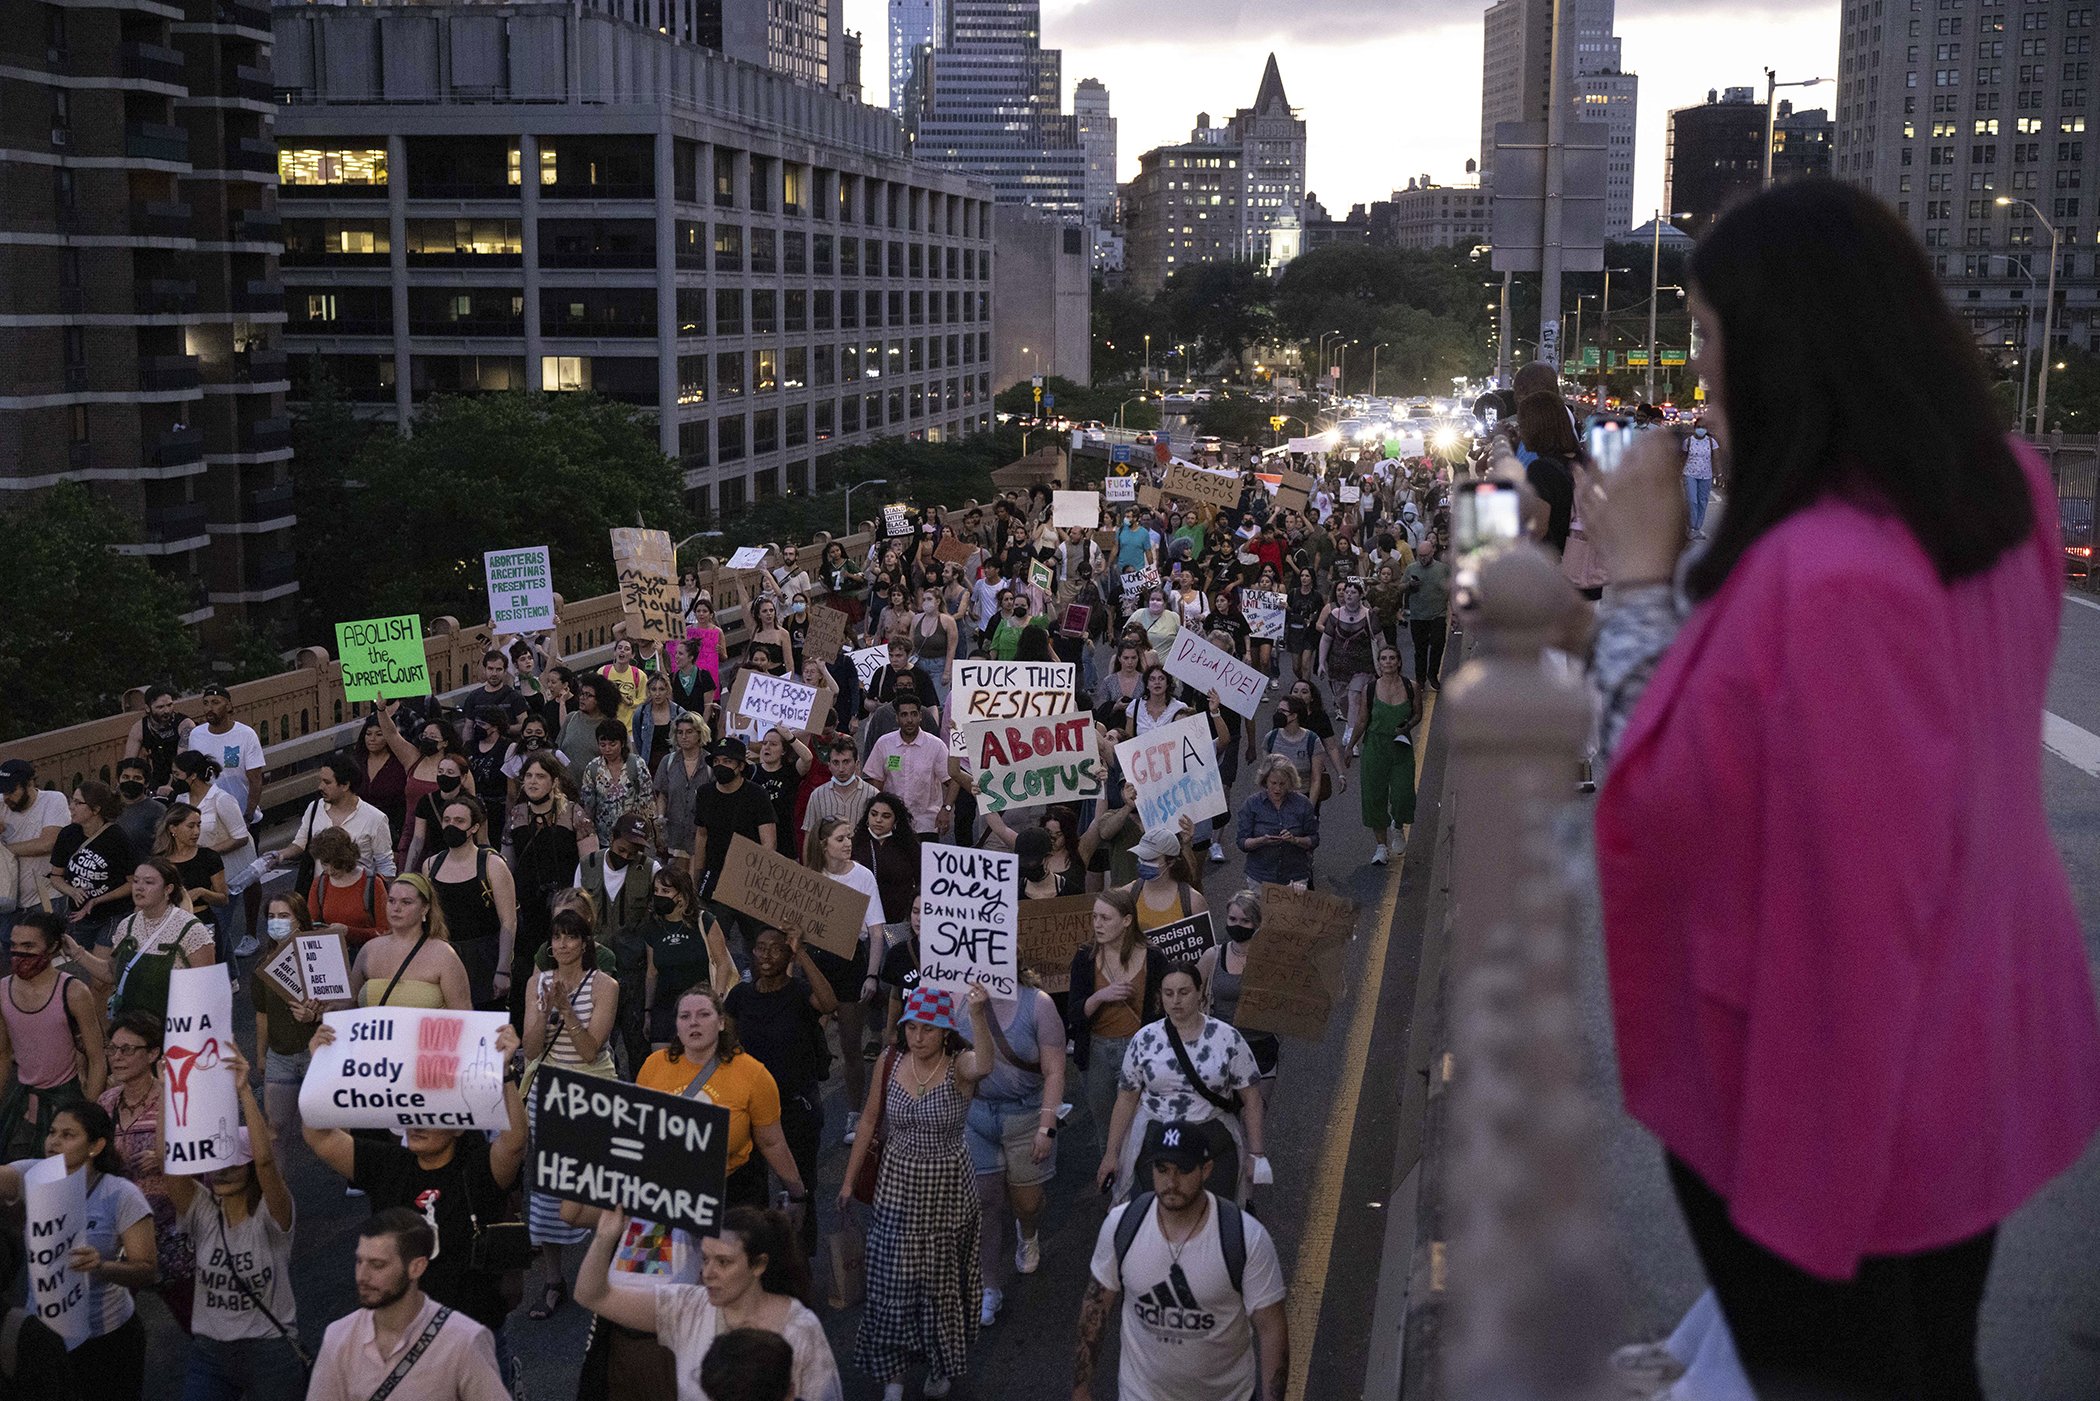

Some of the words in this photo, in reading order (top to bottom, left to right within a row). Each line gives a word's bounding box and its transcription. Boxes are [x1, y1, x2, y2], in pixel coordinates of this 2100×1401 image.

[1107, 479, 1132, 488] FUCK
[1173, 466, 1208, 482] FUCK
[1212, 473, 1234, 489] YOU
[884, 506, 905, 514] STAND
[492, 578, 546, 593] PRESENTES
[511, 595, 528, 607] EN
[495, 606, 549, 622] RESISTENCIA
[343, 618, 414, 648] ABOLISH
[367, 647, 389, 664] the
[961, 665, 1018, 688] FUCK
[1025, 666, 1073, 689] THIS!
[751, 676, 781, 697] MY
[781, 683, 815, 706] BODY
[745, 696, 771, 713] MY
[771, 703, 810, 721] CHOICE
[980, 717, 1091, 770] ABORT
[1131, 740, 1176, 785] GET
[1183, 735, 1205, 773] A
[978, 758, 1102, 812] SCOTUS
[78, 856, 97, 870] OUR
[768, 859, 795, 883] YOU
[932, 850, 1012, 883] YOU'RE
[744, 870, 771, 894] LIKE
[774, 882, 834, 918] ABORTION?
[924, 902, 1005, 925] BANNING
[806, 919, 829, 939] ONE
[1148, 924, 1195, 945] ascism
[302, 941, 307, 950] I
[306, 940, 322, 950] WILL
[930, 922, 1009, 965] SAFE
[1162, 940, 1186, 956] not
[1187, 936, 1204, 949] Be
[306, 952, 317, 961] AID
[279, 962, 296, 977] ABET
[309, 964, 314, 973] &
[311, 974, 326, 984] ABET
[903, 968, 920, 984] OU
[922, 961, 1015, 995] abortions
[272, 967, 303, 995] ABORTION
[313, 985, 344, 995] ABORTION
[166, 1016, 193, 1033] OW
[199, 1014, 212, 1031] A
[349, 1019, 394, 1042] Still
[342, 1057, 404, 1083] Body
[332, 1088, 425, 1108] Choice
[396, 1111, 475, 1127] BITCH
[543, 1077, 713, 1152] ABORTION
[1163, 1128, 1181, 1146] NY
[537, 1150, 719, 1226] HEALTHCARE
[32, 1213, 68, 1237] MY
[209, 1248, 253, 1272] BAES
[37, 1265, 66, 1293] MY
[37, 1283, 83, 1319] OICE
[1134, 1301, 1216, 1330] adidas
